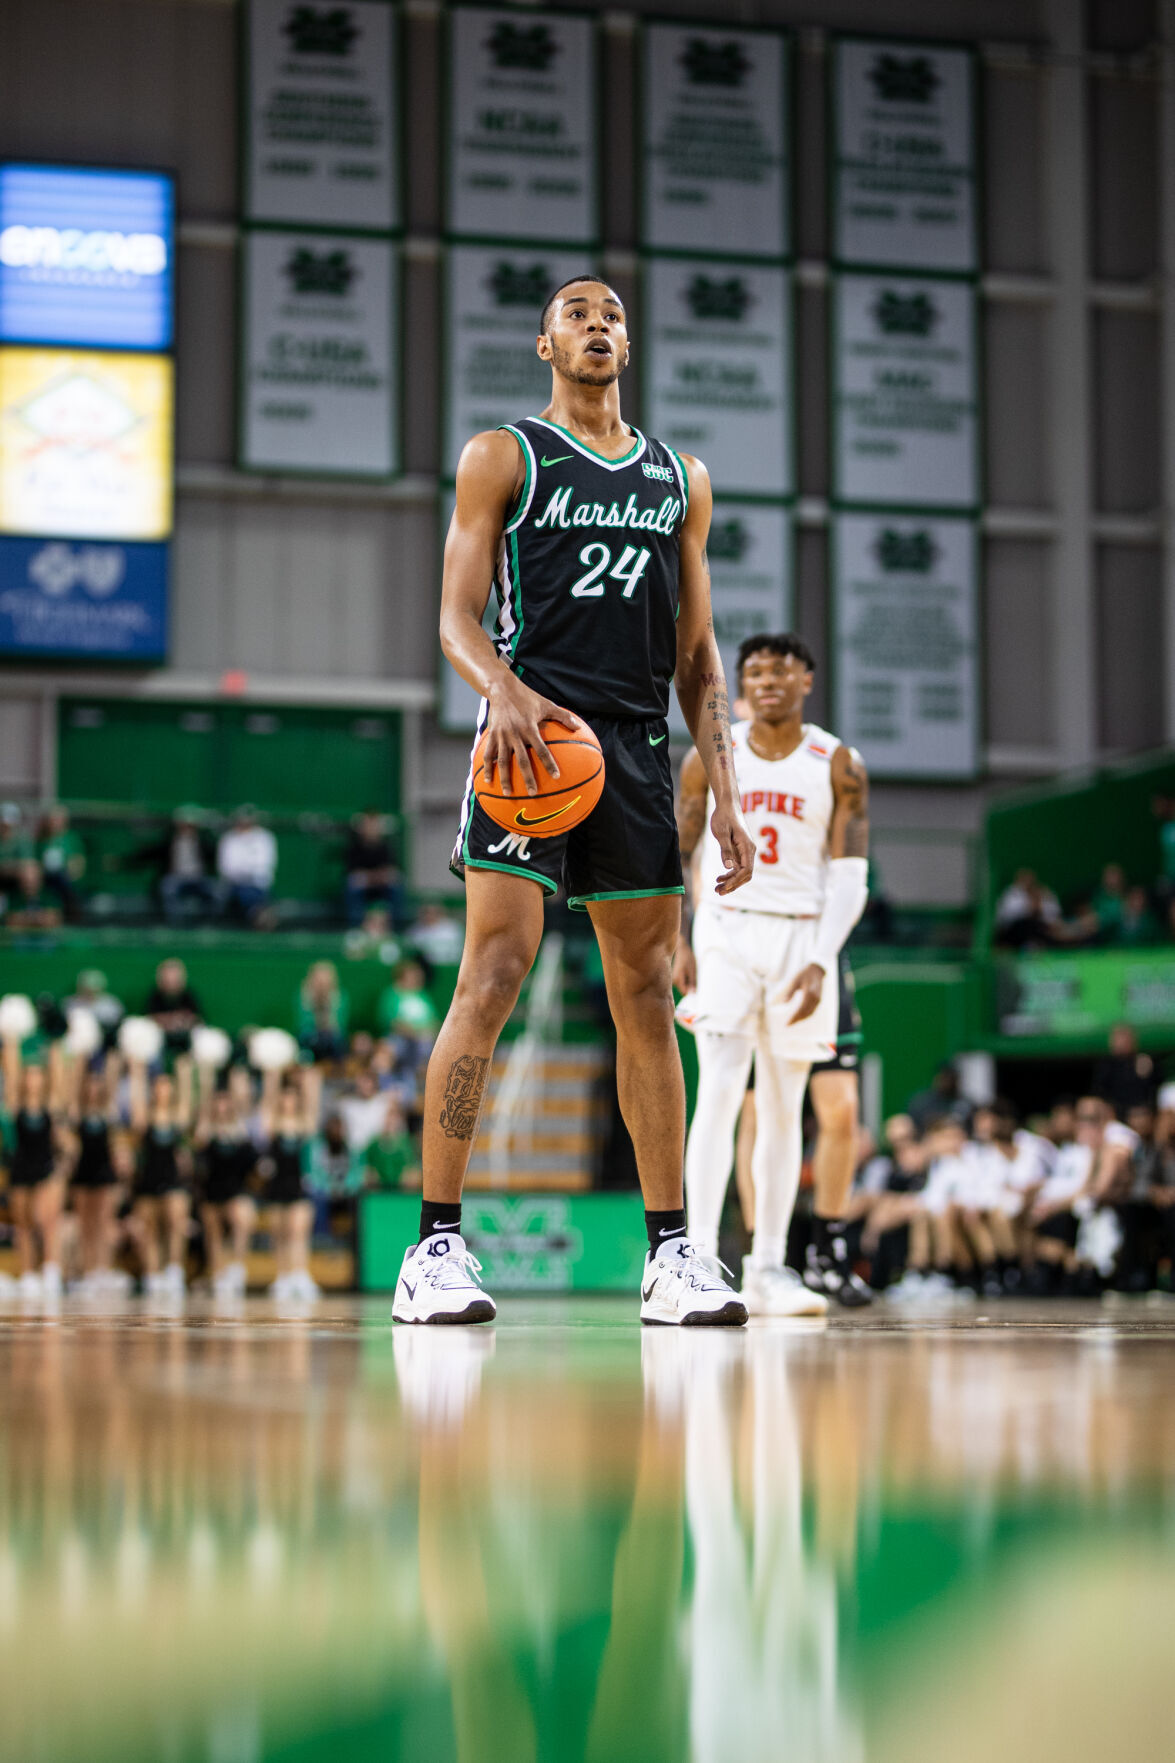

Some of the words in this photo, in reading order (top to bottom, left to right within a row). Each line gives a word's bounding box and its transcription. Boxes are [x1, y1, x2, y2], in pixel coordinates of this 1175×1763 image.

[533, 485, 682, 537] Marshall
[569, 542, 653, 600] 24
[487, 832, 531, 861] M
[759, 825, 779, 865] 3
